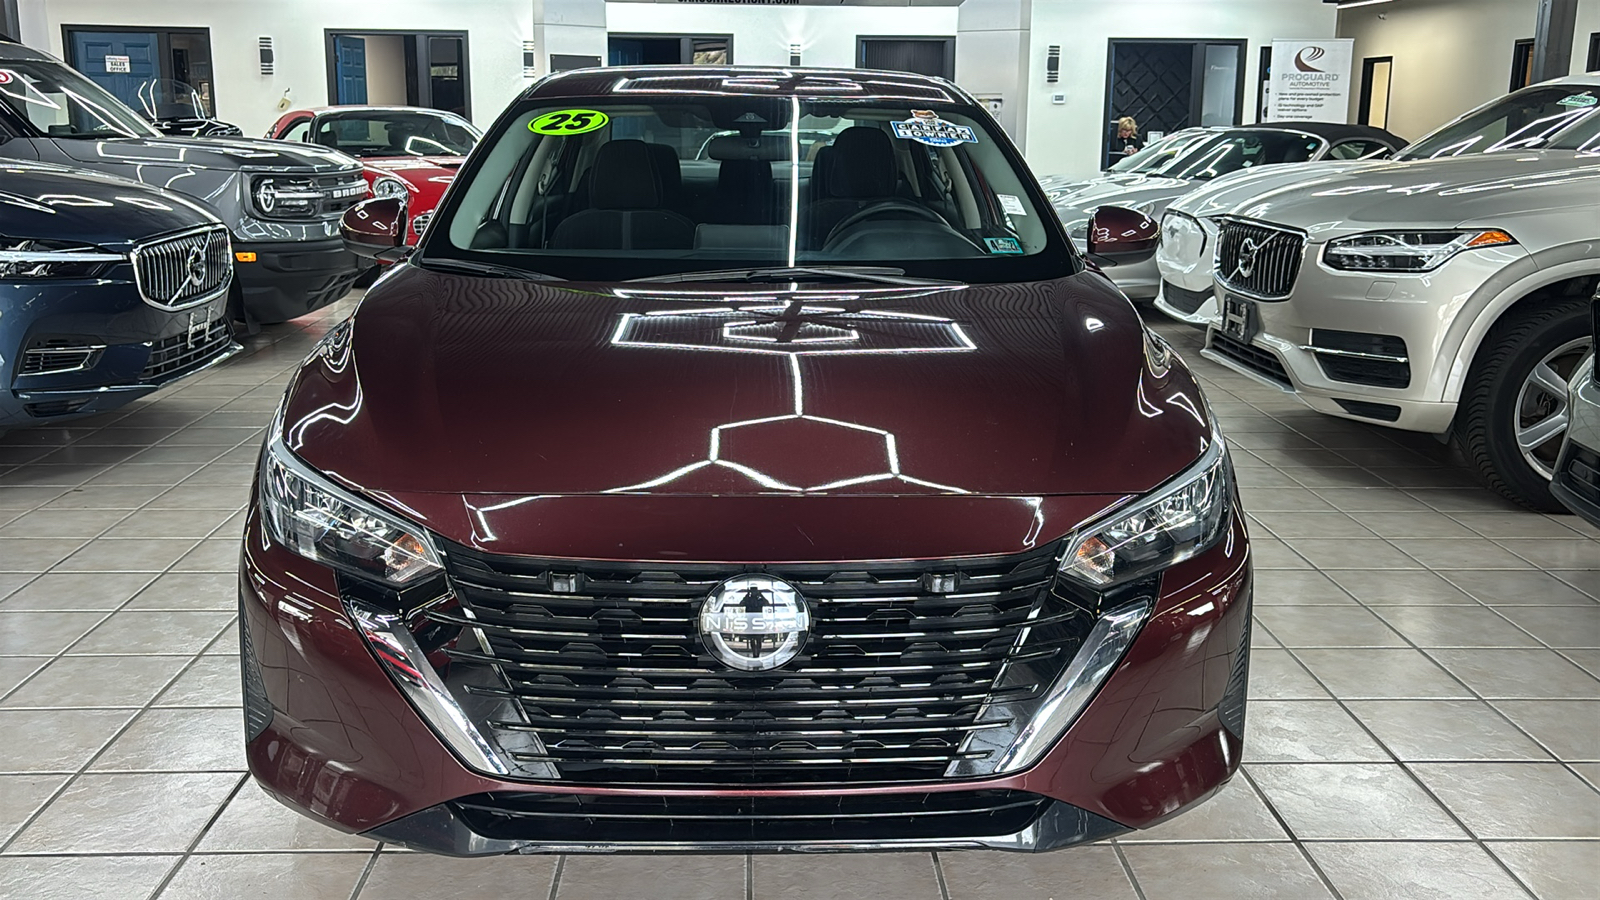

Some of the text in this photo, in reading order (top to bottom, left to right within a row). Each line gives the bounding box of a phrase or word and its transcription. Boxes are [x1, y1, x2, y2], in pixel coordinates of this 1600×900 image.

[1281, 73, 1339, 81] PROGUARD
[541, 113, 597, 130] 25
[897, 124, 968, 134] CARFAX
[912, 131, 973, 140] OWNER
[333, 186, 368, 198] BRONC
